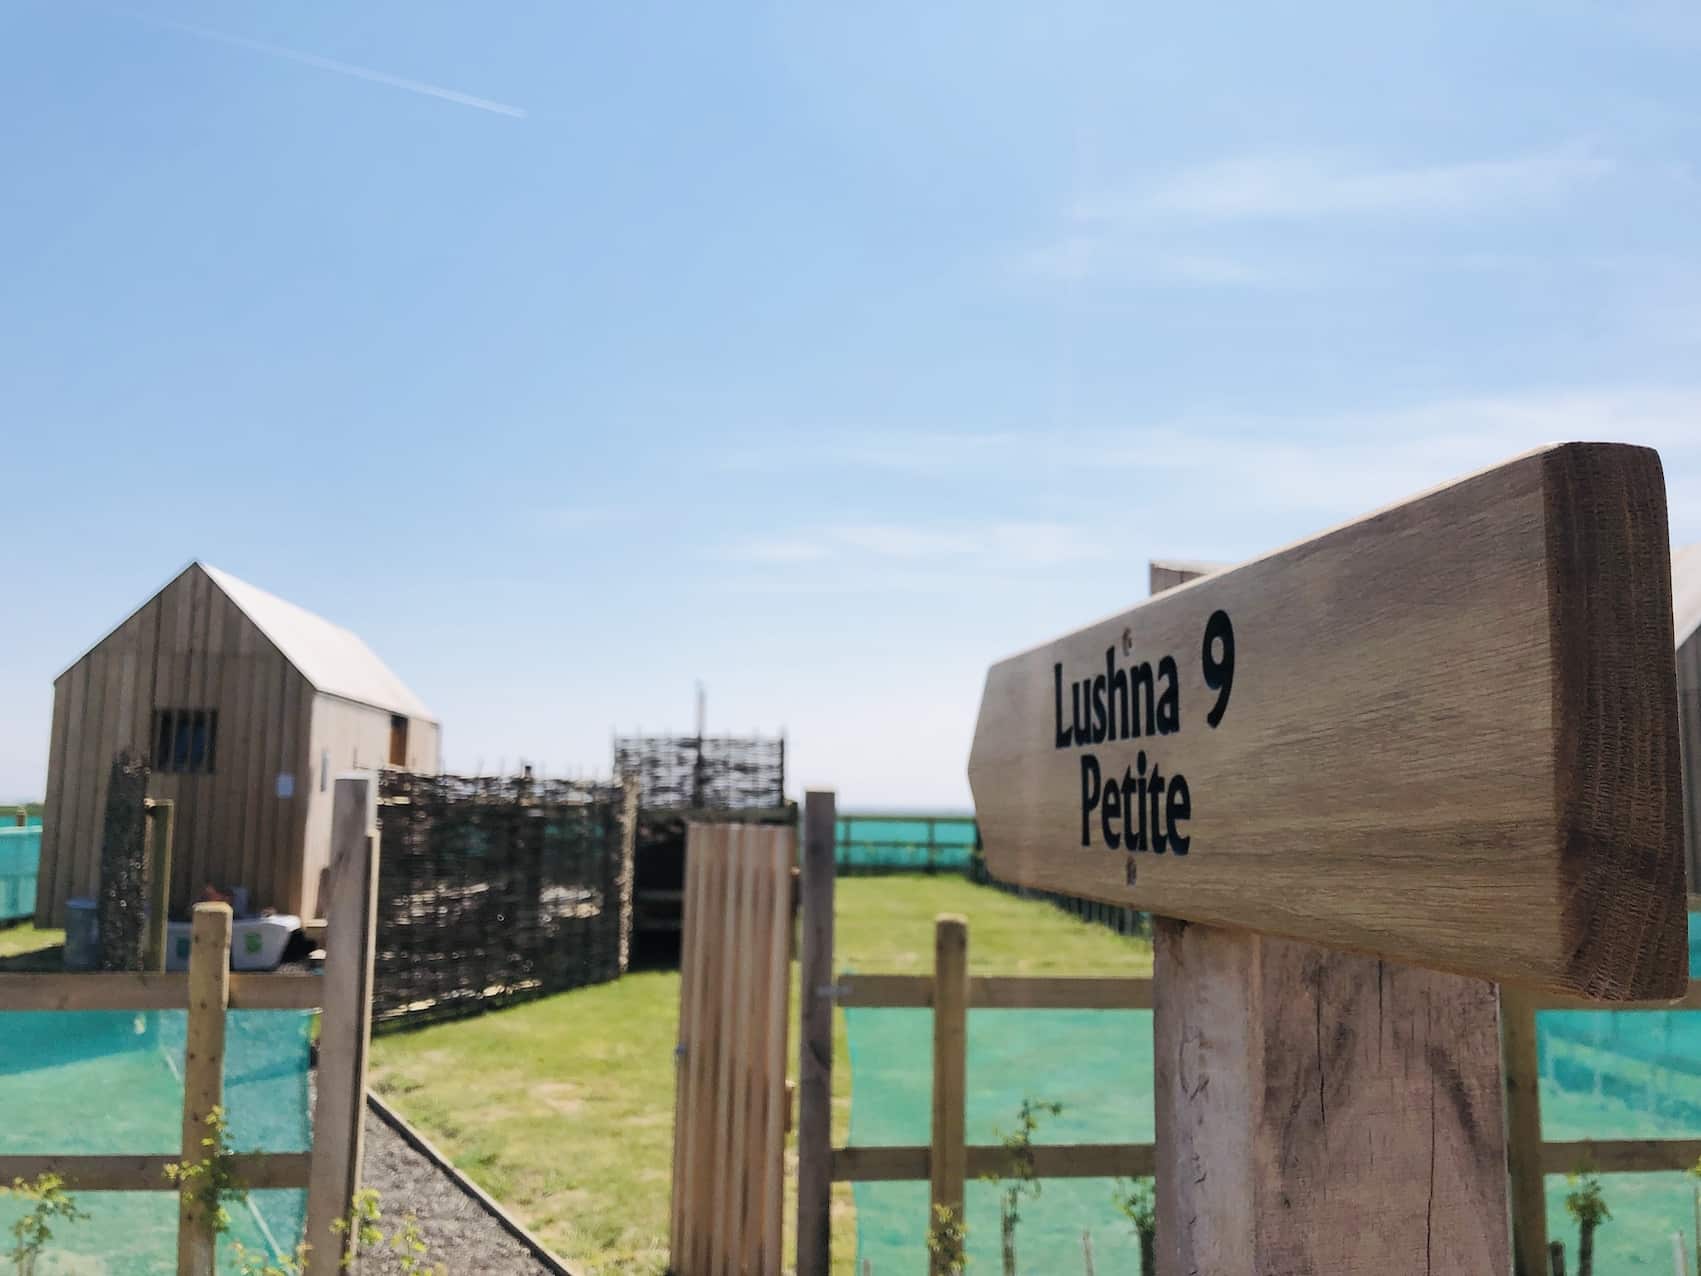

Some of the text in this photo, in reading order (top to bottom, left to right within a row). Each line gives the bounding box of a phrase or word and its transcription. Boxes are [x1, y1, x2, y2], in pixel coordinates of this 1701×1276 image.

[1053, 609, 1235, 749] Lushna 9
[1080, 750, 1192, 855] Petite
